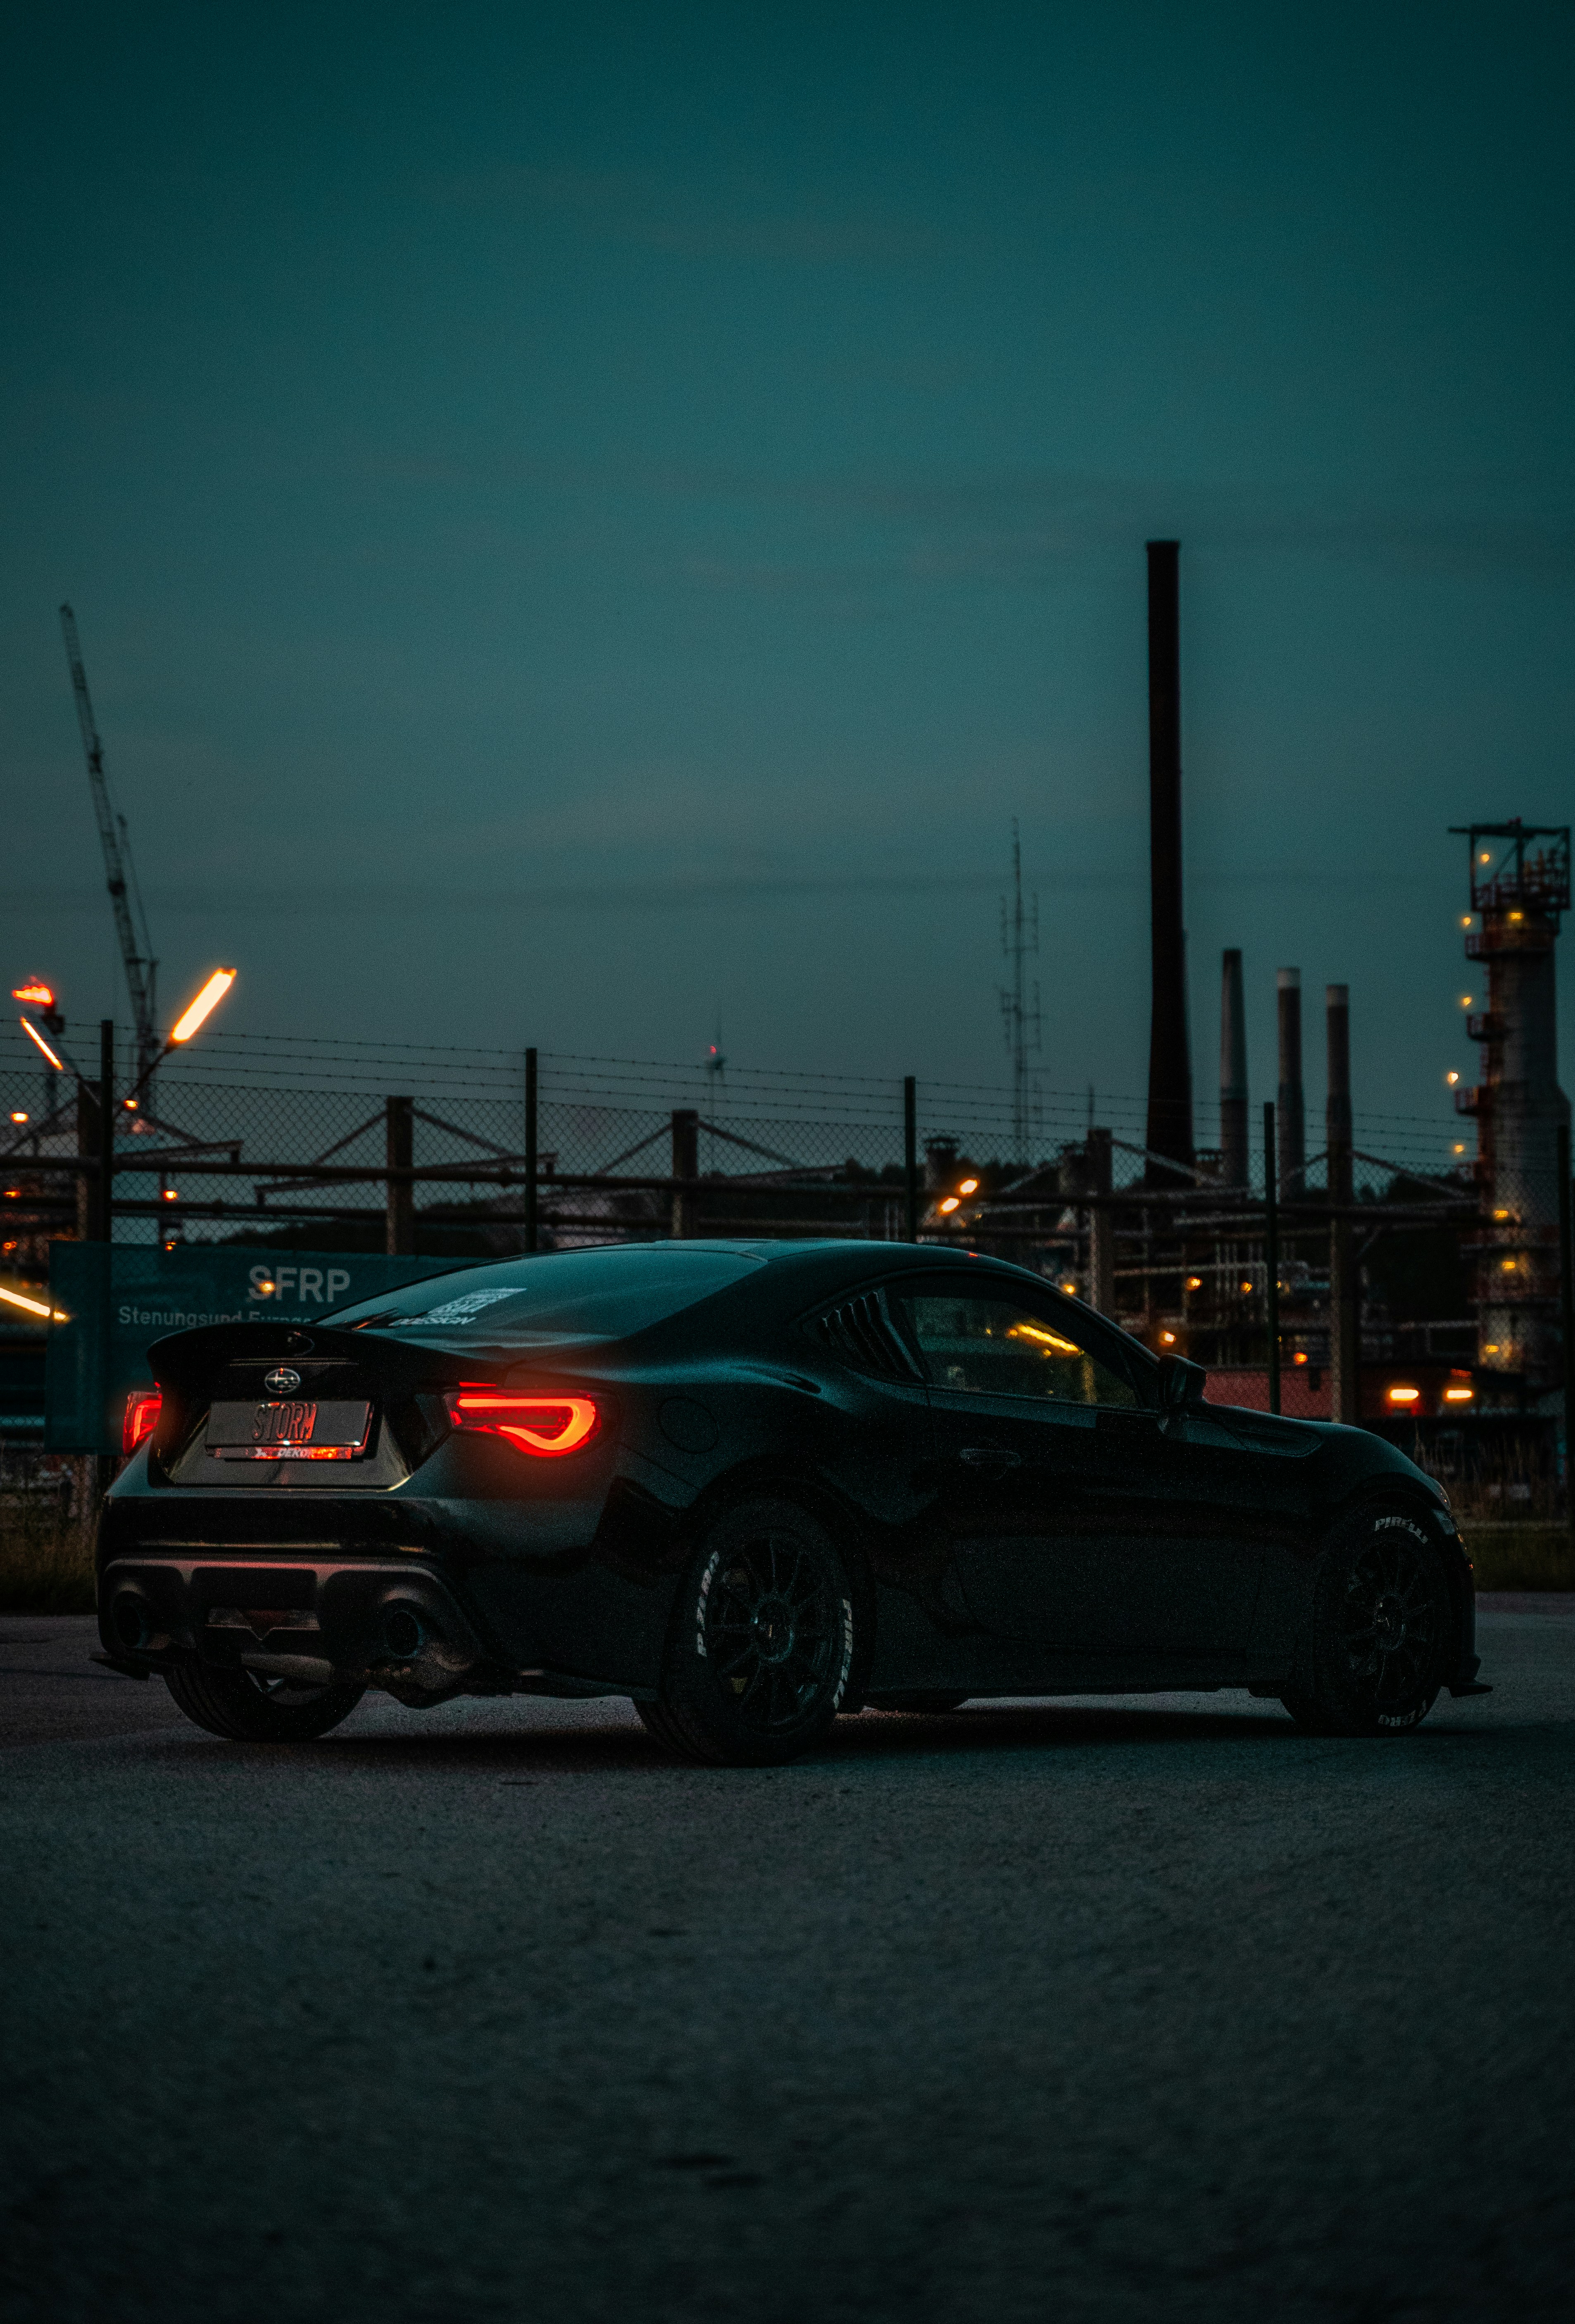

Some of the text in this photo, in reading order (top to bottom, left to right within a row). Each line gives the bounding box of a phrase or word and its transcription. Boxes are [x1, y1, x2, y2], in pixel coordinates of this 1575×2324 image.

[248, 1265, 350, 1302] SFRP
[251, 1403, 318, 1440] STORM
[1374, 1516, 1429, 1544] PIRELLI
